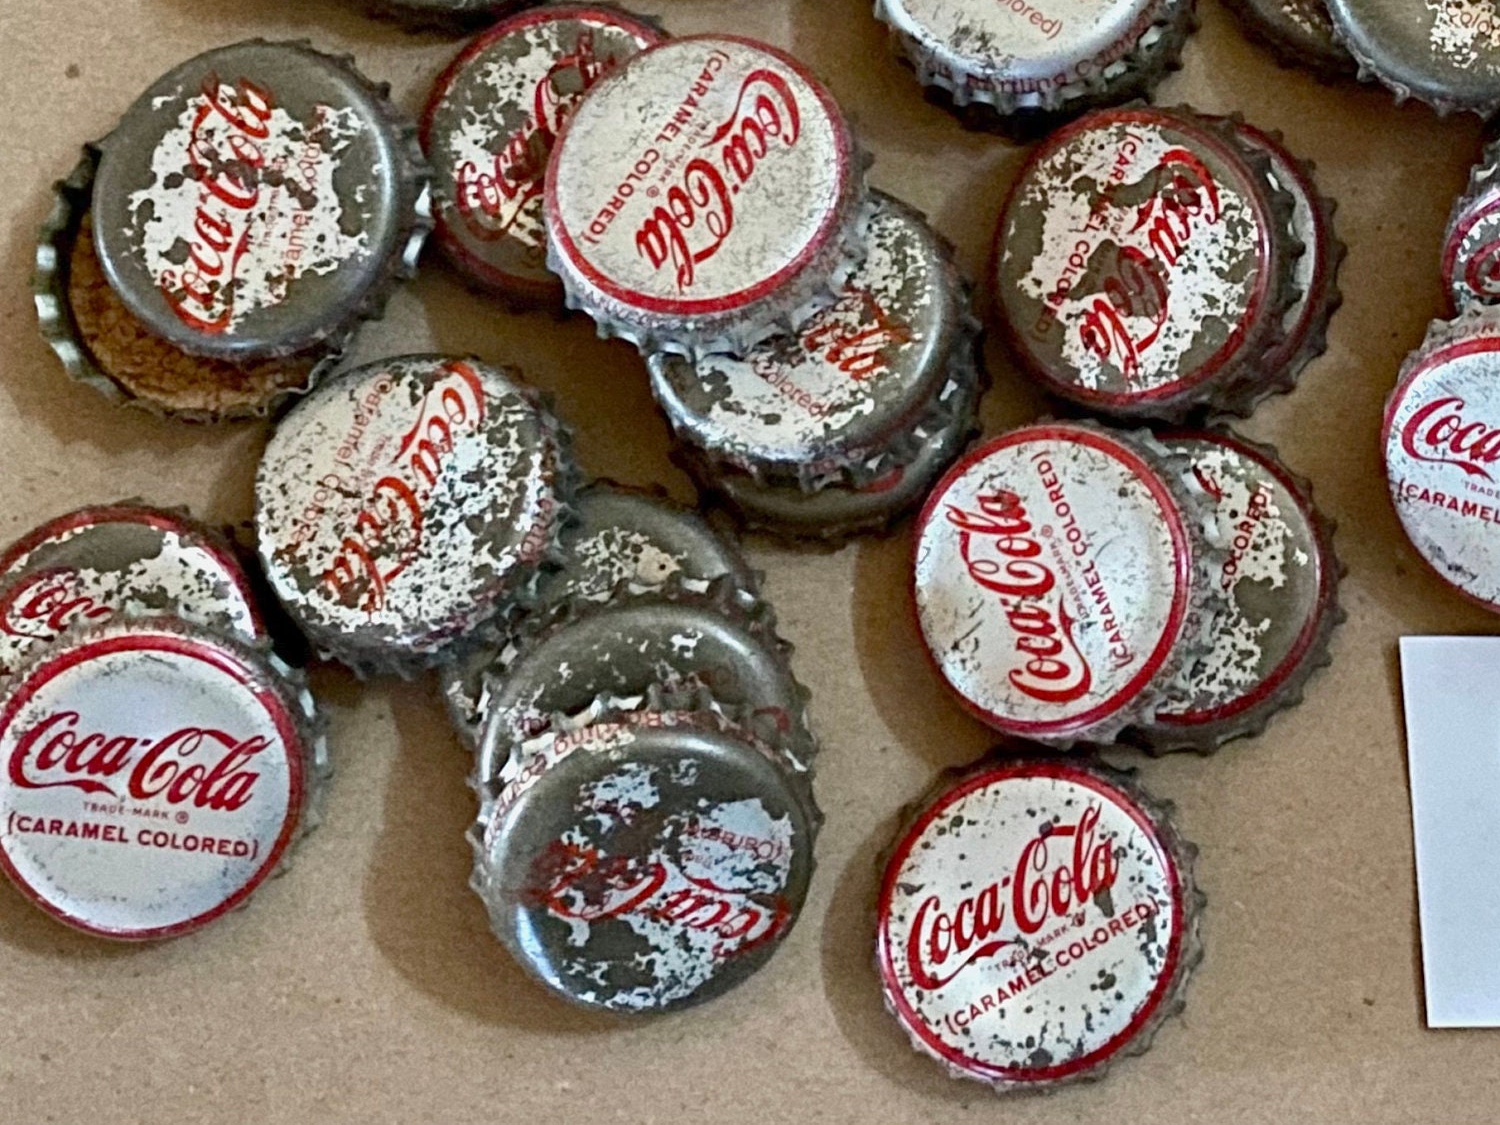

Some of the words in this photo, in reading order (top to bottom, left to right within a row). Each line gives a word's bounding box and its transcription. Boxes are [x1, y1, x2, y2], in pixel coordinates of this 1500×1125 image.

[652, 49, 731, 152] (CARAMEL
[580, 146, 663, 248] COLORED)
[7, 810, 129, 845] (CARAMEL
[138, 829, 259, 860] COLORED)
